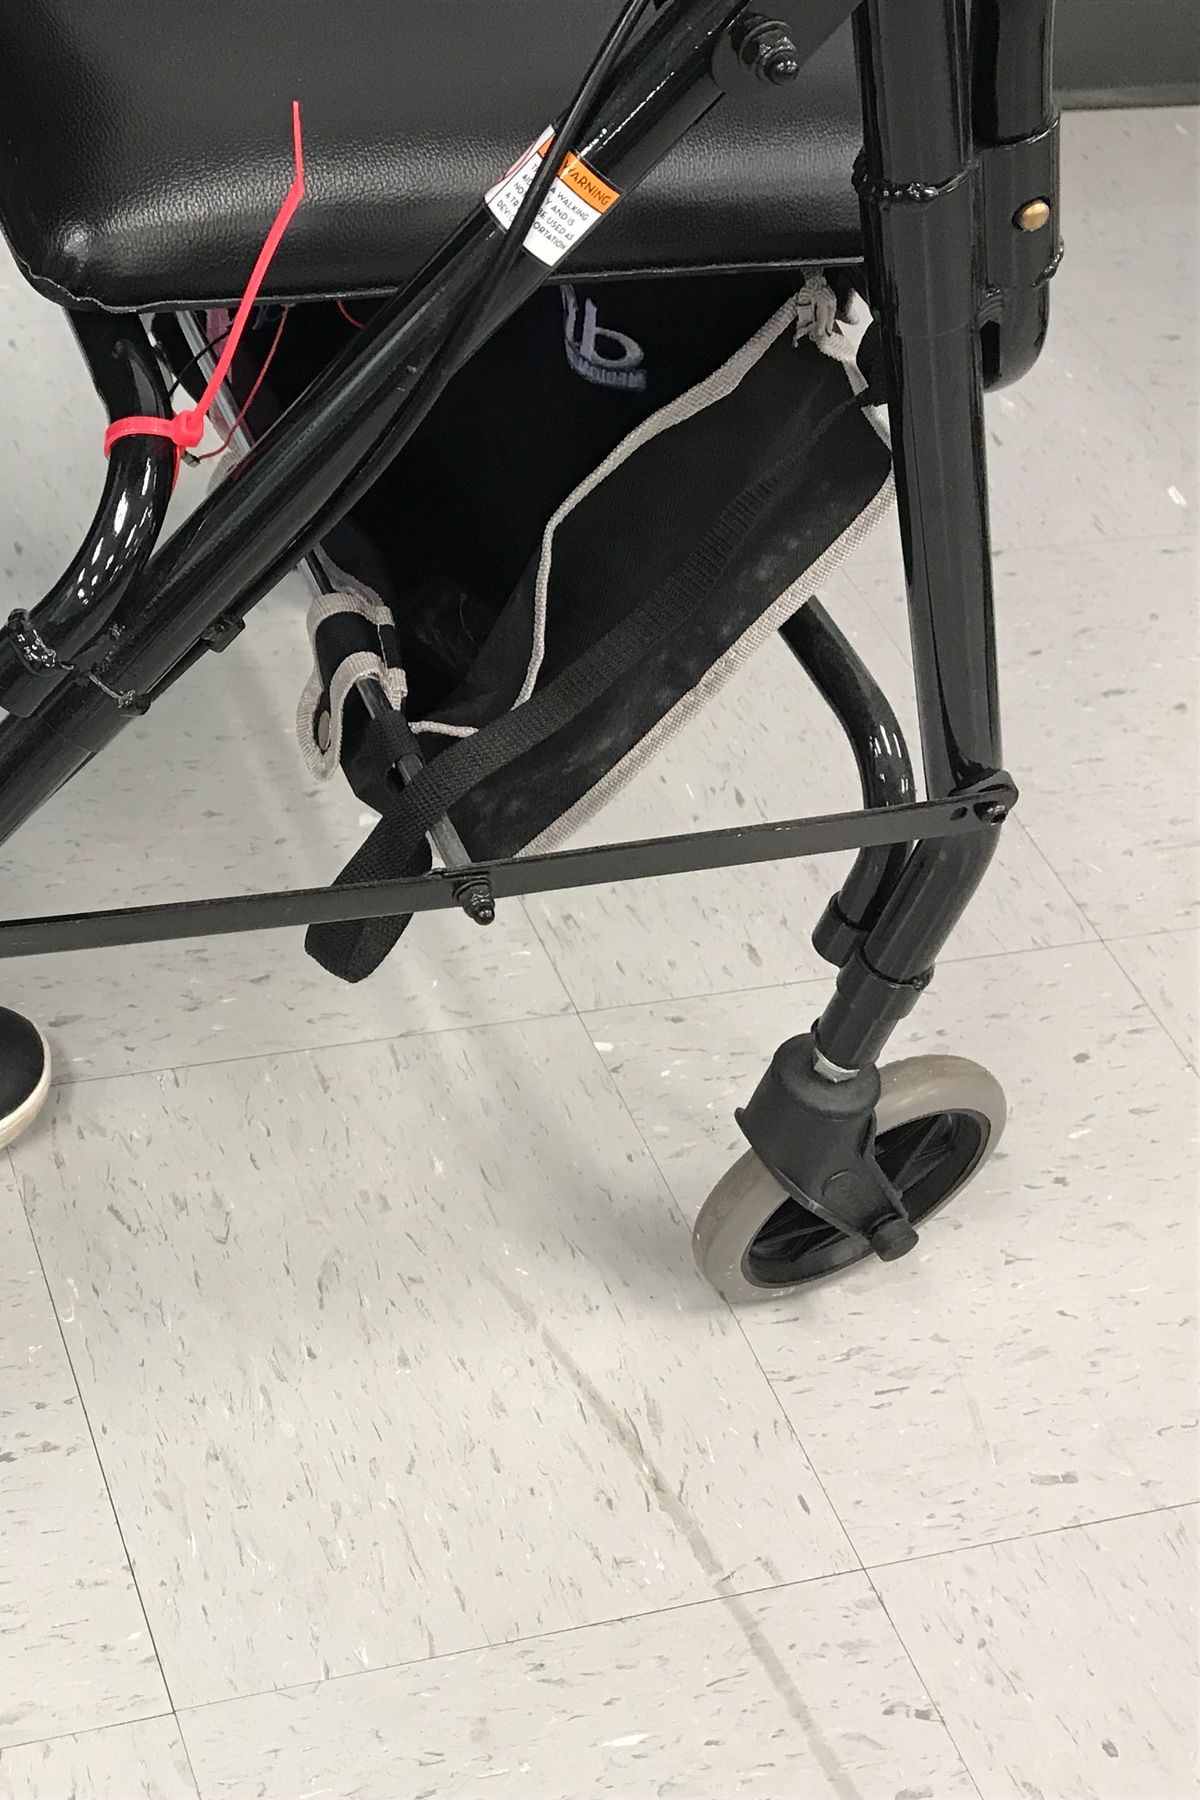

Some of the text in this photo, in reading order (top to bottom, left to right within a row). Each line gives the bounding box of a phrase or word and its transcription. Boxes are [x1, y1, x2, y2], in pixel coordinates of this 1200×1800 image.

[563, 159, 612, 206] WARNING
[496, 199, 516, 223] DEVIC
[550, 205, 568, 221] AND
[567, 218, 575, 226] IS
[557, 192, 590, 221] WALKING
[546, 216, 567, 235] USED
[565, 232, 575, 241] AS
